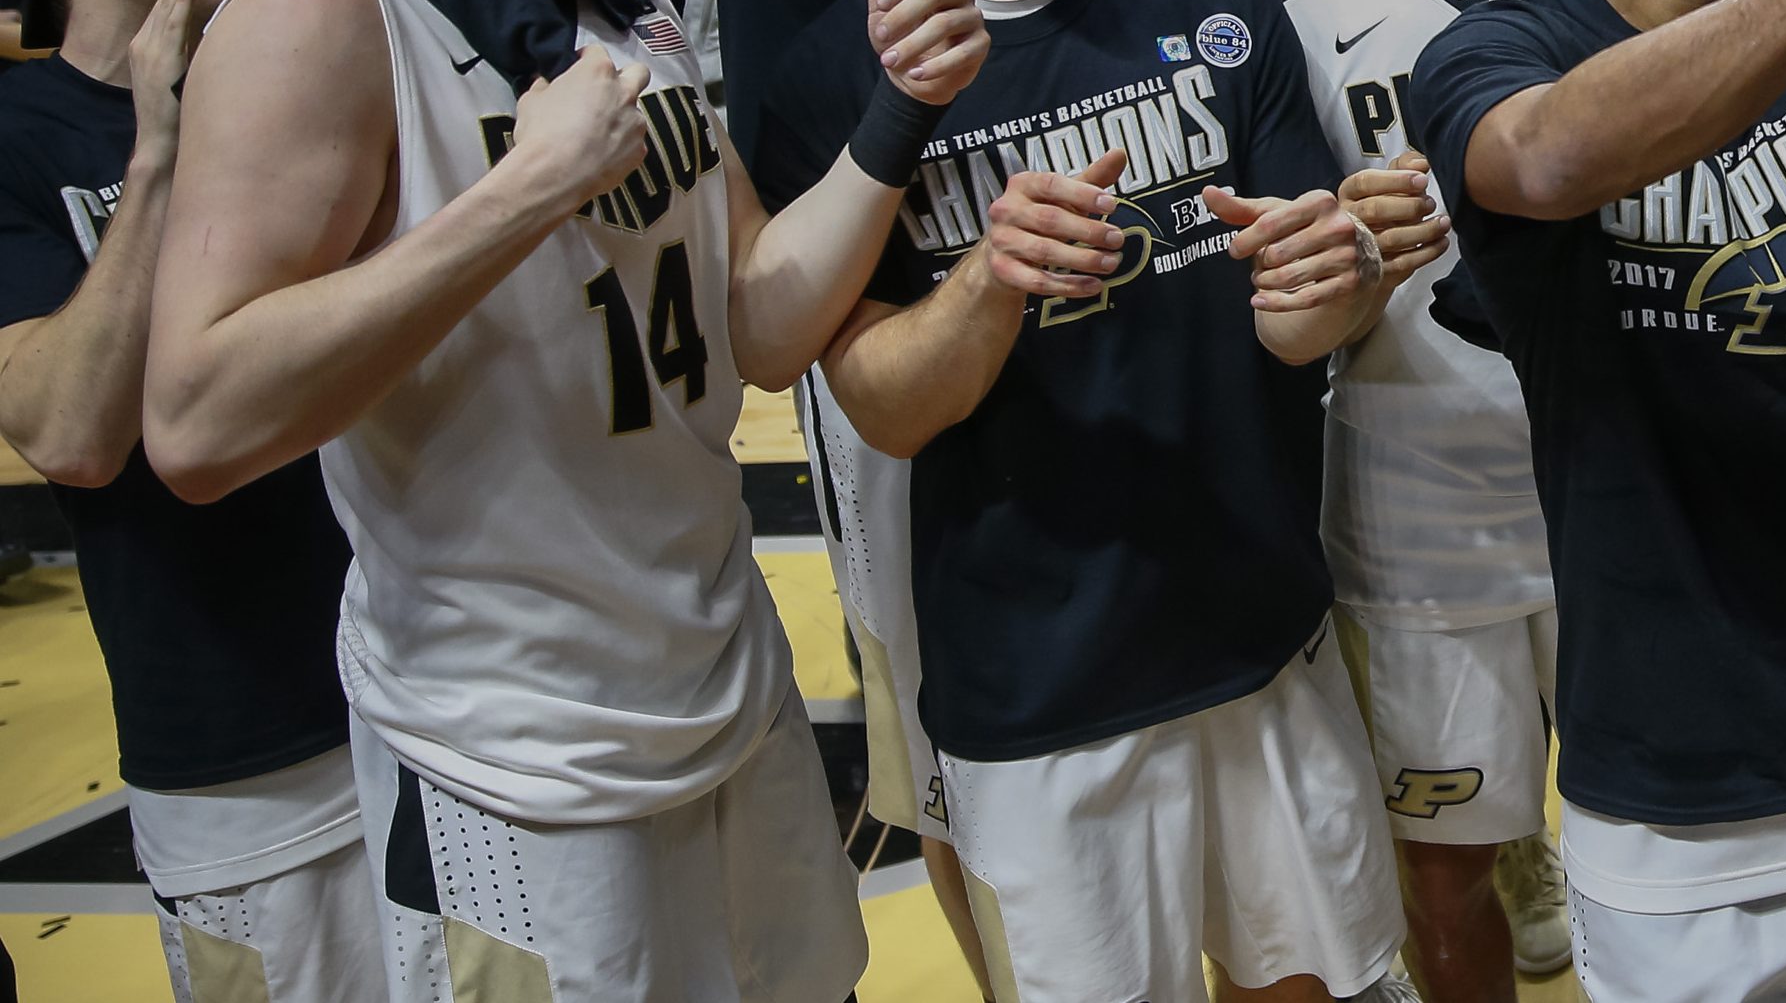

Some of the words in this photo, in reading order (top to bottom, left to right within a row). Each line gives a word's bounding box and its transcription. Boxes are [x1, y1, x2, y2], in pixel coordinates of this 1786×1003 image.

[1202, 34, 1228, 45] blue
[1231, 37, 1247, 48] 84
[1208, 20, 1241, 35] OFFICIAL
[993, 111, 1052, 141] MEN'S
[1056, 75, 1167, 124] BASKETBALL
[98, 181, 124, 202] BI
[1607, 258, 1676, 291] 2017
[1621, 308, 1718, 333] URDUE
[584, 237, 708, 436] 14
[1385, 766, 1484, 820] P
